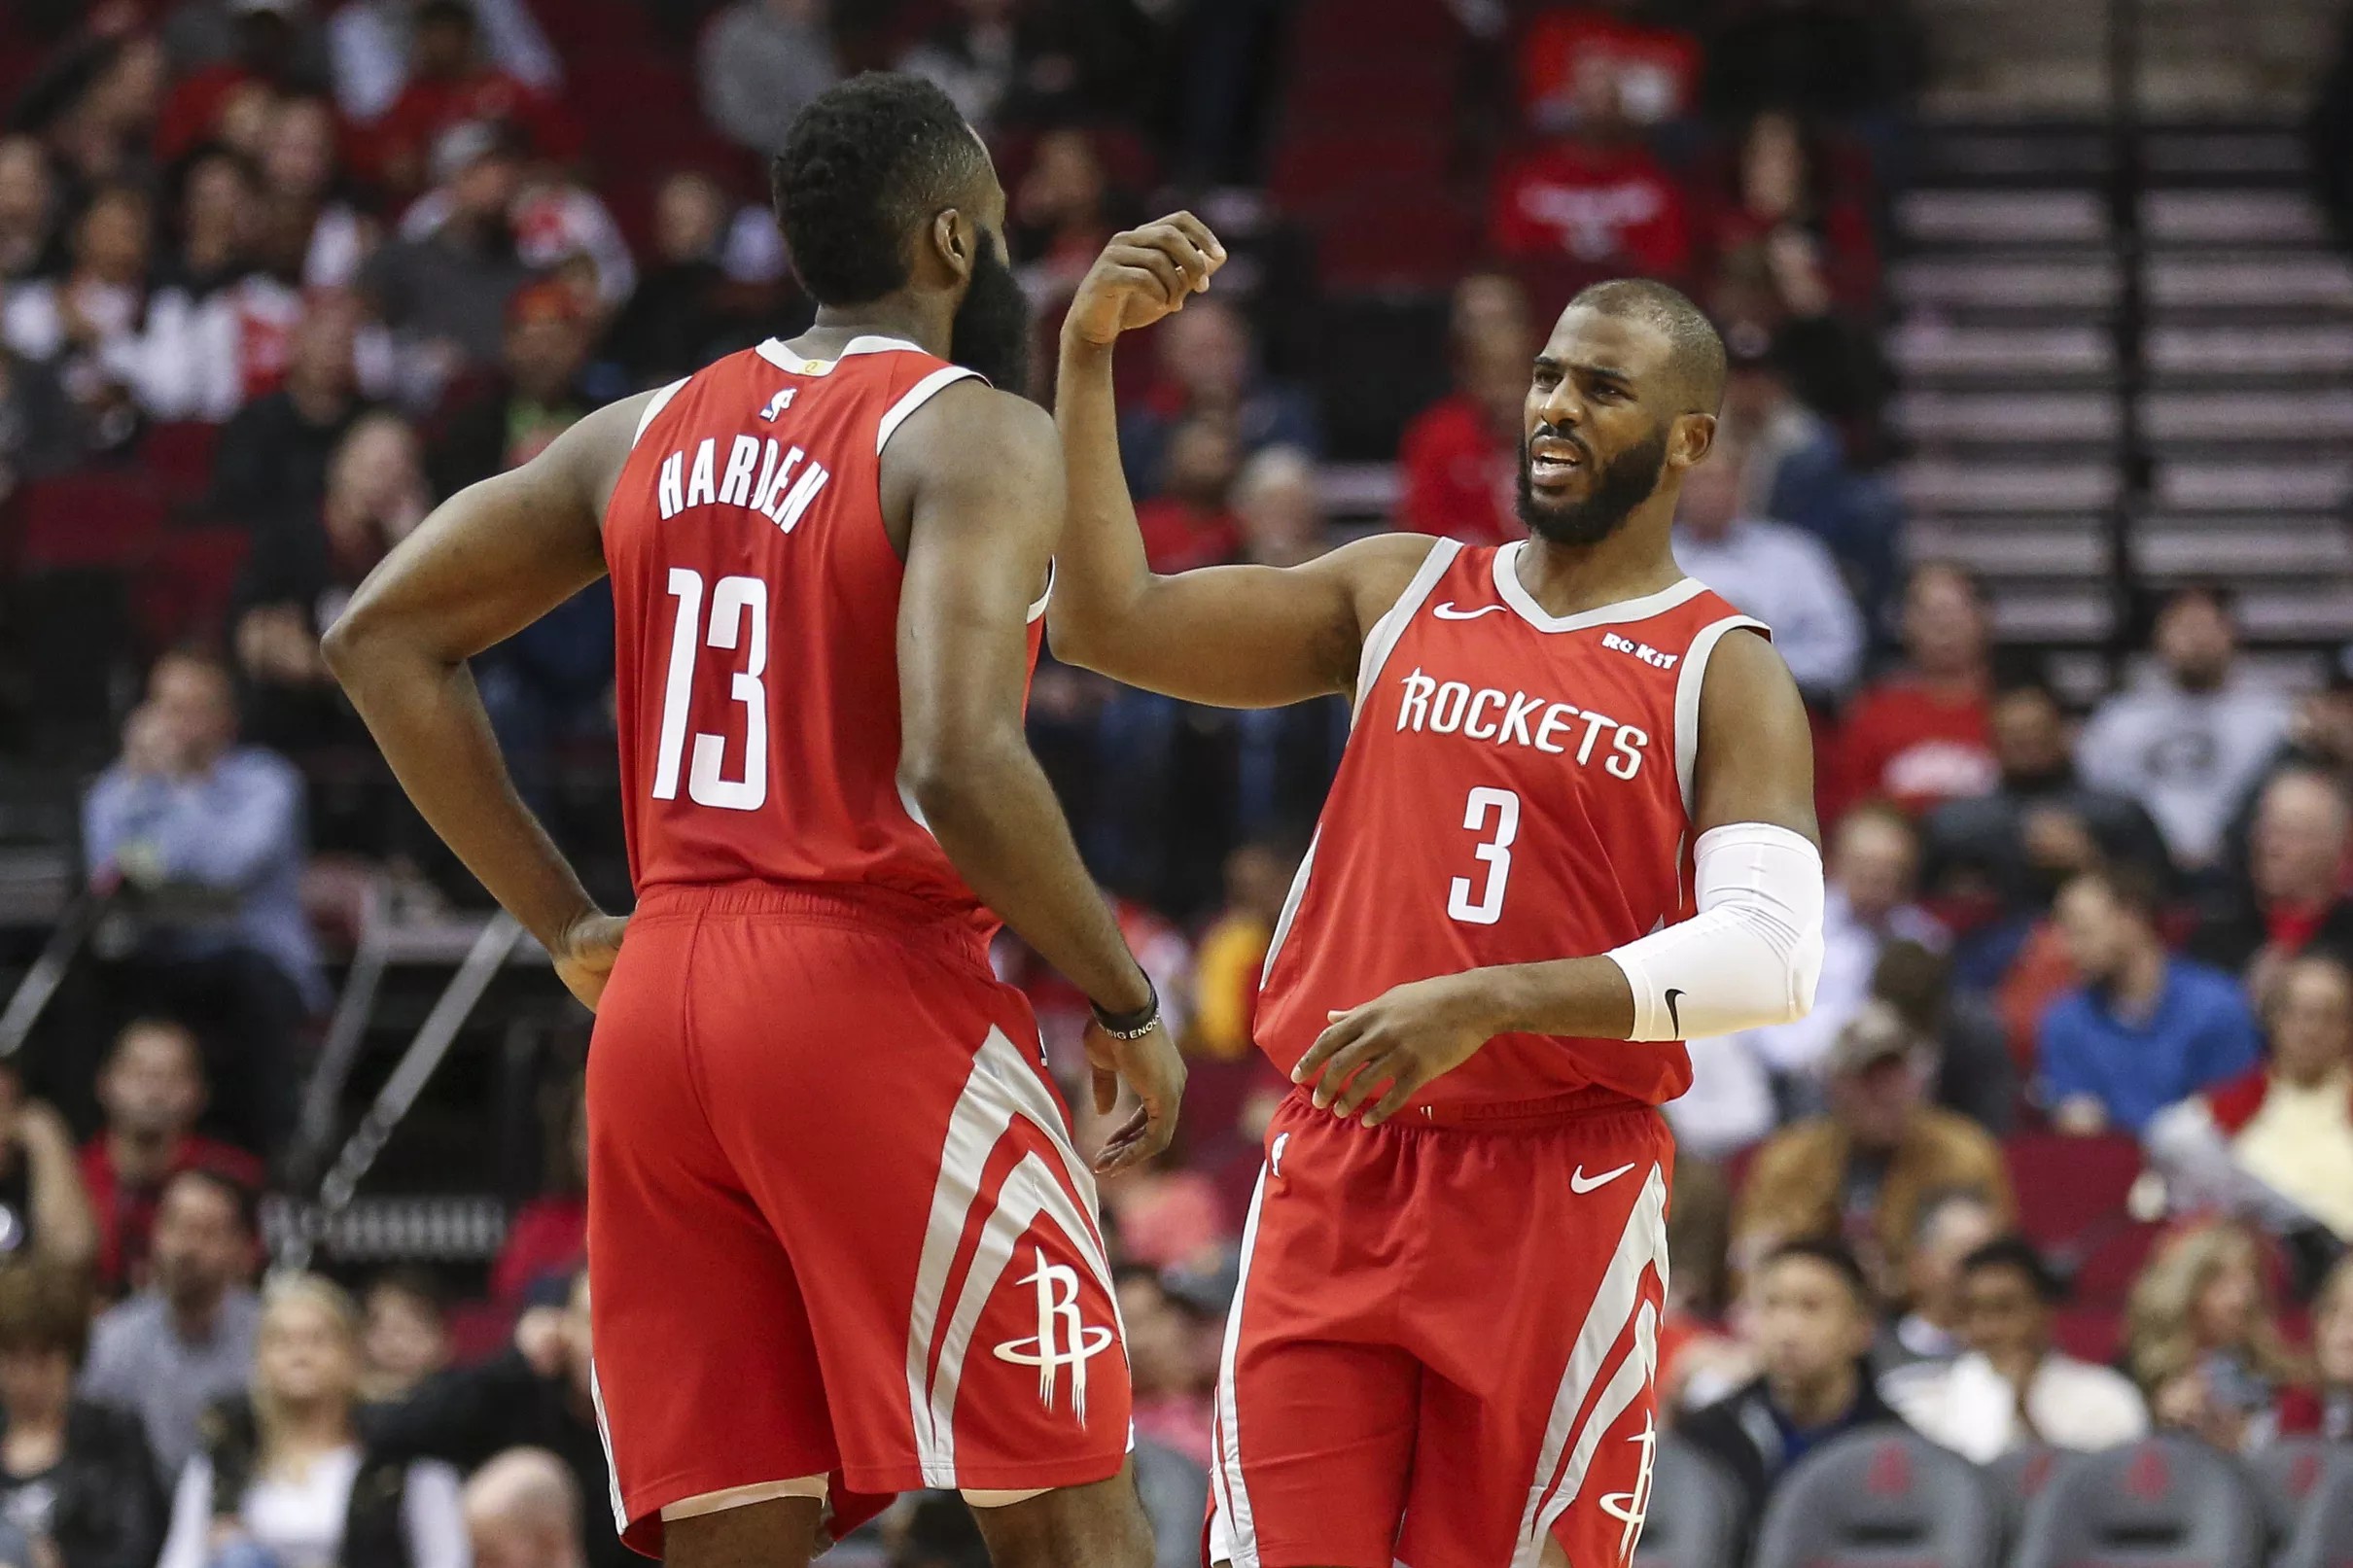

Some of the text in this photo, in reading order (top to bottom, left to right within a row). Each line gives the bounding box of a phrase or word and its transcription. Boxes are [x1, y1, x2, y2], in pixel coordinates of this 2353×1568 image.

[658, 434, 829, 535] HARDEN
[652, 568, 768, 811] 13
[1396, 666, 1649, 781] ROCKETS
[1447, 786, 1520, 925] 3
[1130, 1010, 1160, 1039] ENOU
